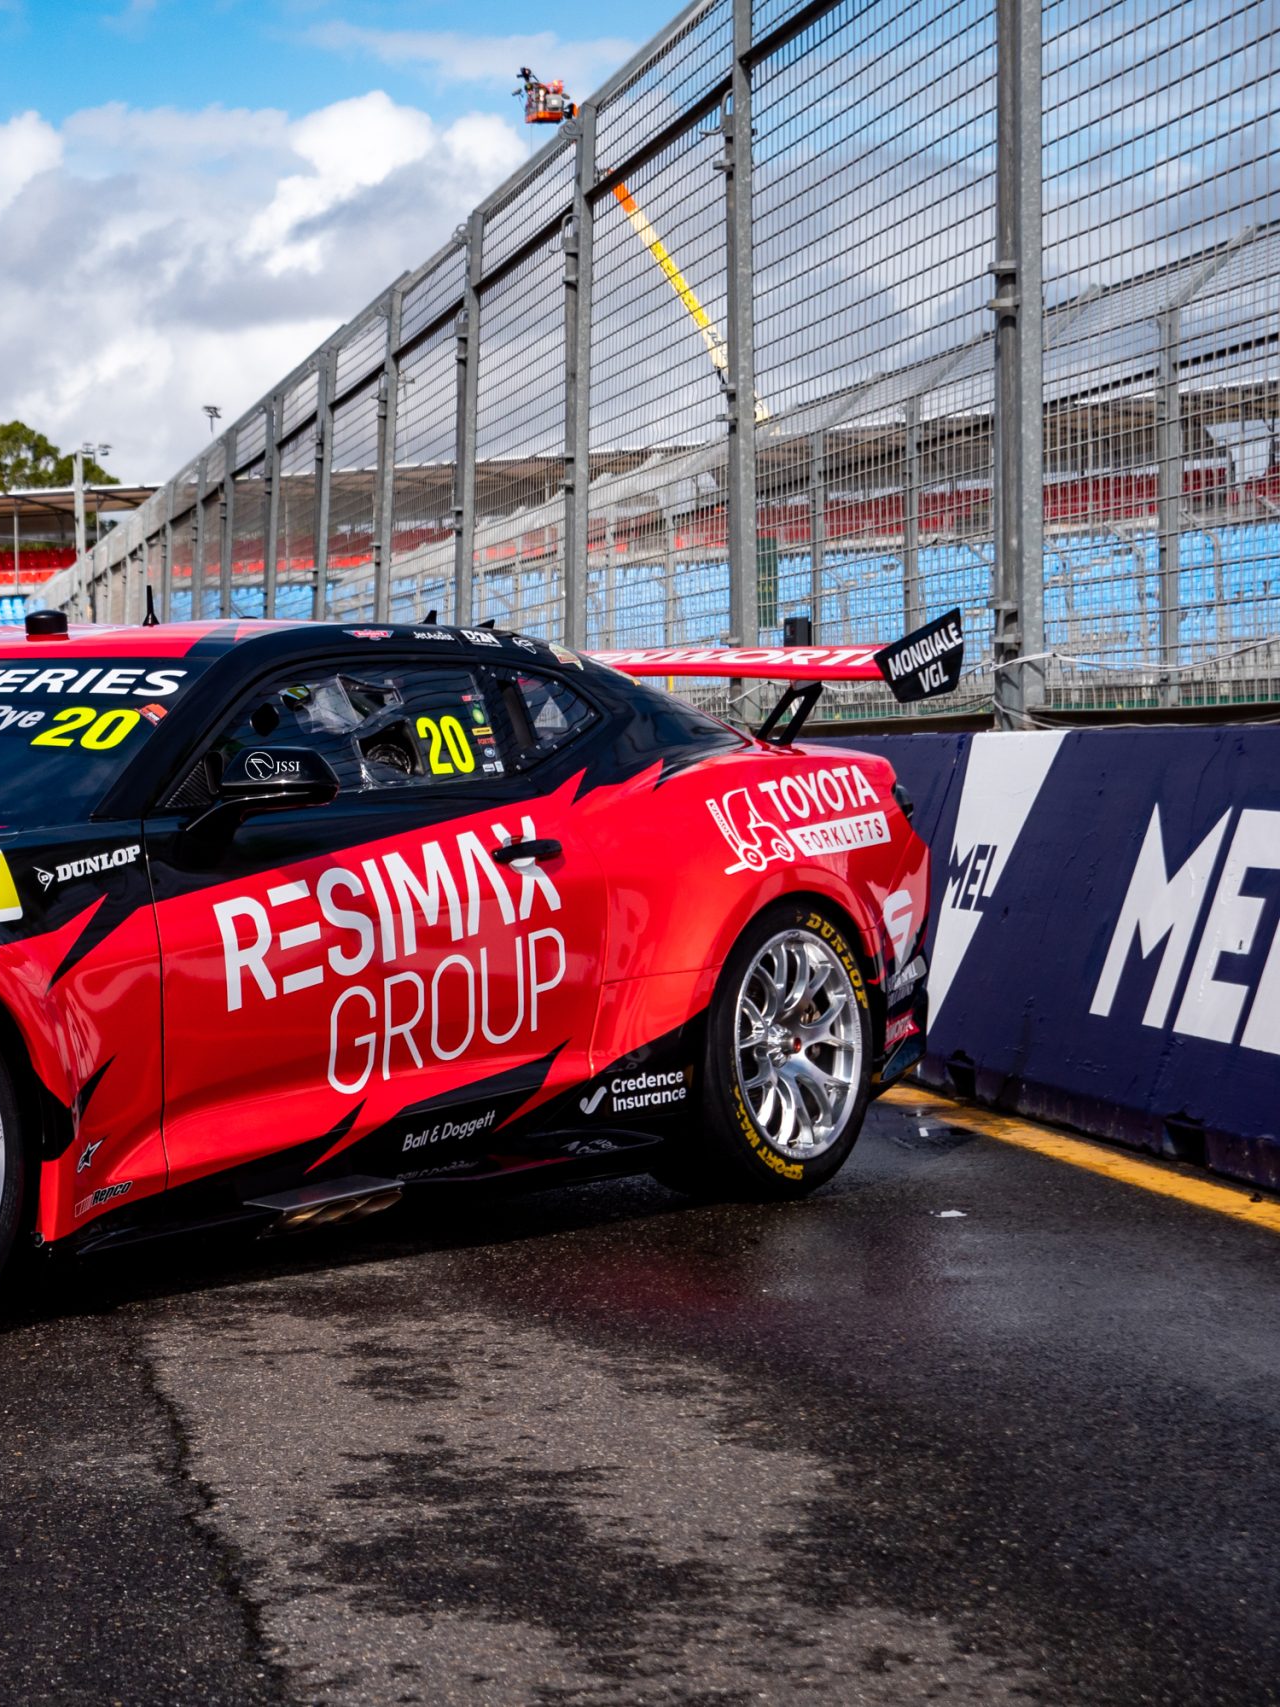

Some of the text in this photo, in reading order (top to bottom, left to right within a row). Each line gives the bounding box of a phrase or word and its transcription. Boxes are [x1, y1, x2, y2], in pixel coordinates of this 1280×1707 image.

[887, 621, 964, 681] MONDIALE
[918, 660, 950, 693] VGL
[30, 706, 141, 751] 20
[416, 715, 475, 775] 20
[274, 760, 301, 775] JSSI
[758, 764, 880, 823] TOYOTA
[799, 815, 885, 852] FORKLIFTS
[55, 844, 141, 883] DUNLOP
[212, 814, 563, 1013] RESIMAX
[806, 912, 869, 1009] DUNLOP
[327, 926, 566, 1095] GROUP
[610, 1069, 685, 1095] Credence
[612, 1086, 687, 1113] Insurance
[402, 1129, 428, 1152] Ball
[441, 1110, 496, 1140] Doggett
[92, 1180, 133, 1206] Repco
